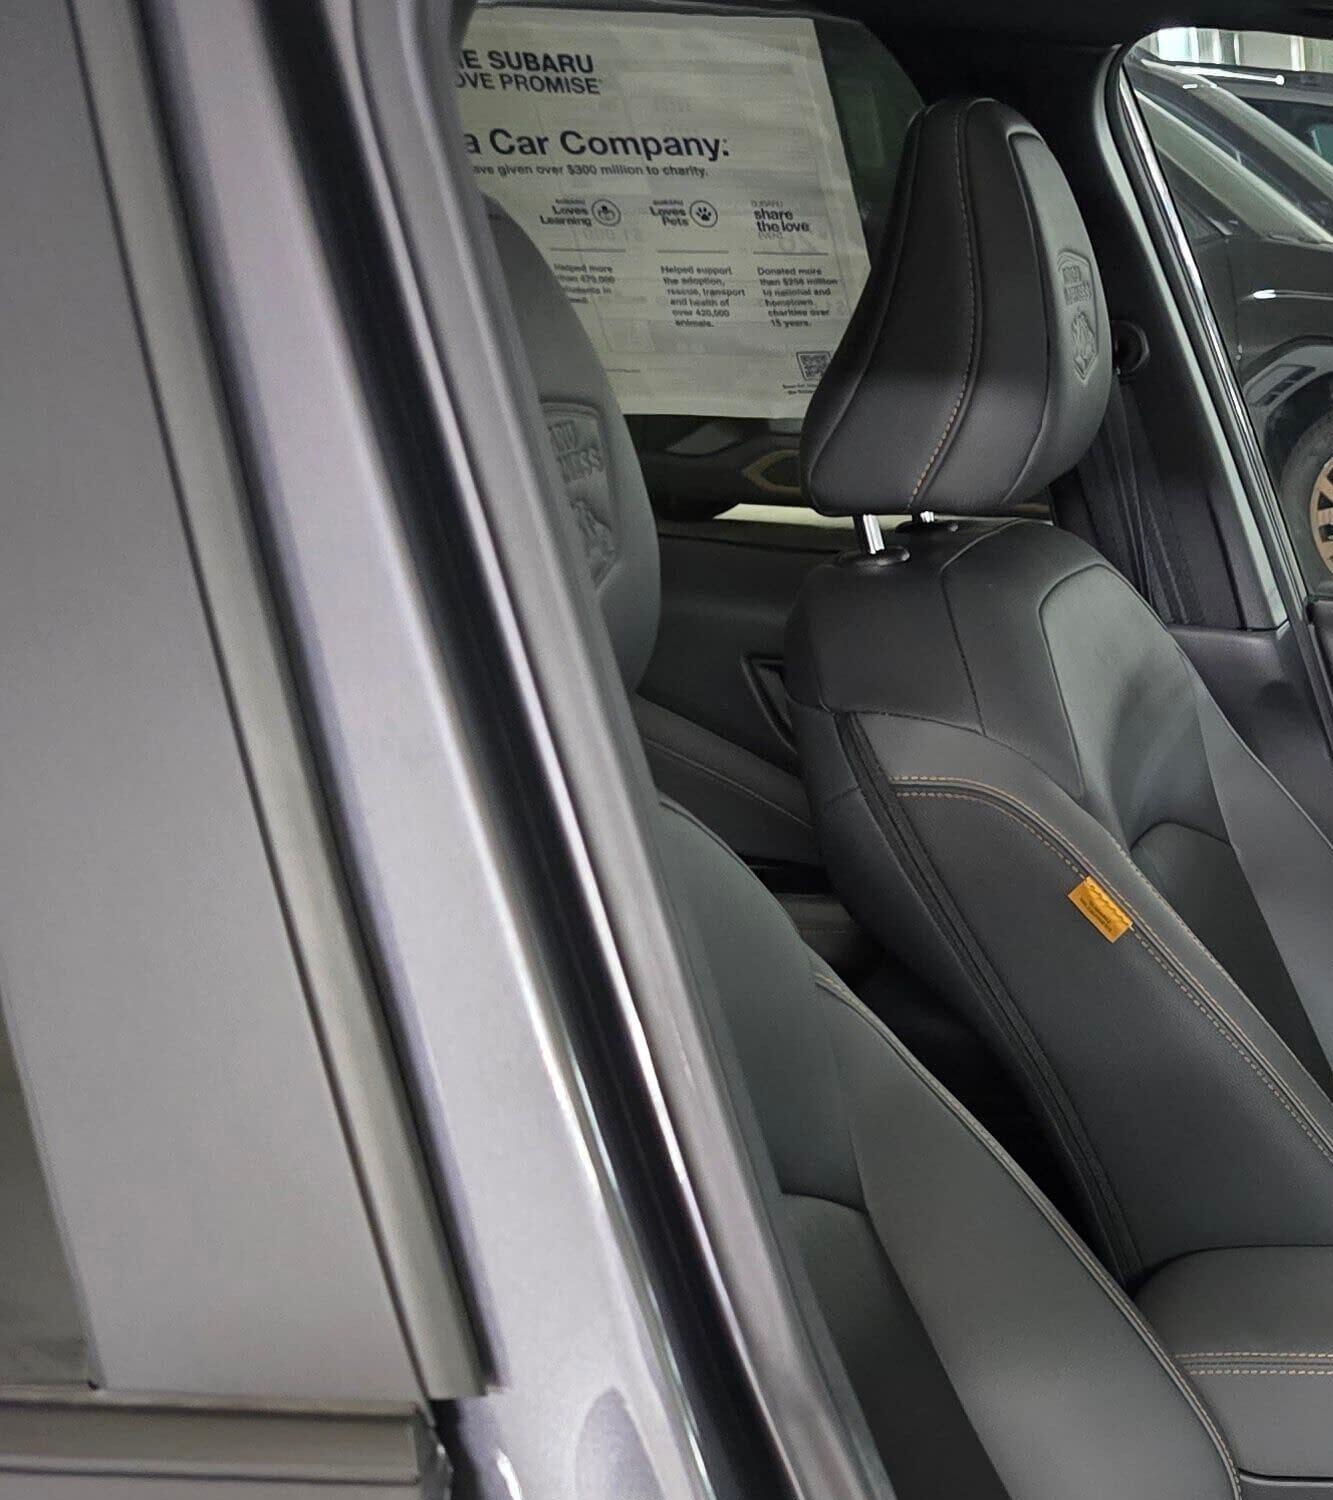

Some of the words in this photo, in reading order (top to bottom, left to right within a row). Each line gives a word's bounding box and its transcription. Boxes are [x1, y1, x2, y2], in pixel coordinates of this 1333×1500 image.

[487, 50, 594, 74] SUBARU
[455, 71, 496, 90] OVE
[499, 73, 600, 95] PROMISE
[463, 133, 481, 154] a
[489, 128, 549, 155] Car
[472, 165, 495, 175] ave
[497, 164, 533, 177] given
[536, 165, 564, 176] over
[567, 164, 597, 175] $300
[600, 164, 643, 176] million
[646, 165, 660, 176] to
[663, 165, 709, 178] charity.
[551, 205, 590, 216] Loves
[650, 206, 687, 217] Loves
[753, 208, 794, 221] share
[539, 215, 593, 227] Learning
[662, 216, 690, 227] Pets
[756, 220, 780, 232] the
[781, 220, 810, 232] love
[757, 266, 796, 276] Donated
